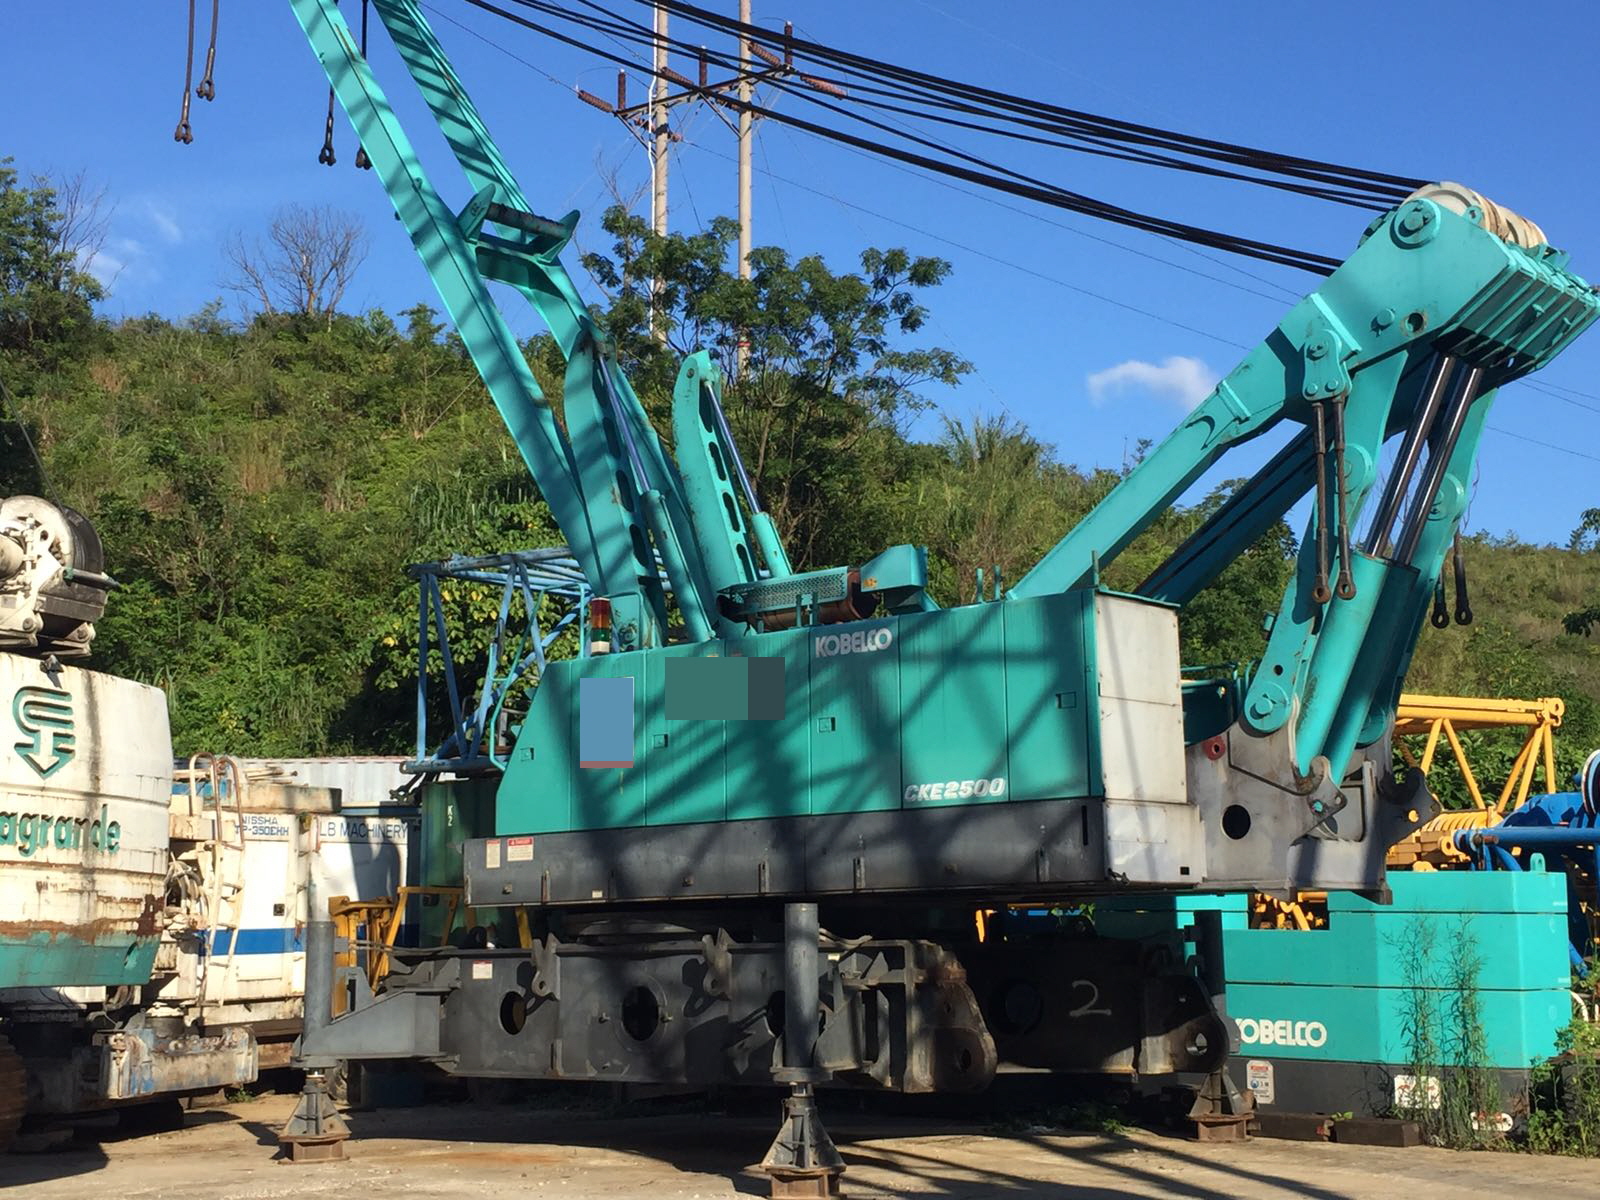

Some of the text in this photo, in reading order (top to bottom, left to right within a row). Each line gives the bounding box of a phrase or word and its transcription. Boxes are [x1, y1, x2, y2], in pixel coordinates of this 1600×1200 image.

[815, 627, 893, 658] KOBELCO
[904, 777, 1006, 802] CKE2500
[340, 821, 409, 839] MACHINERY
[1069, 980, 1112, 1017] 2
